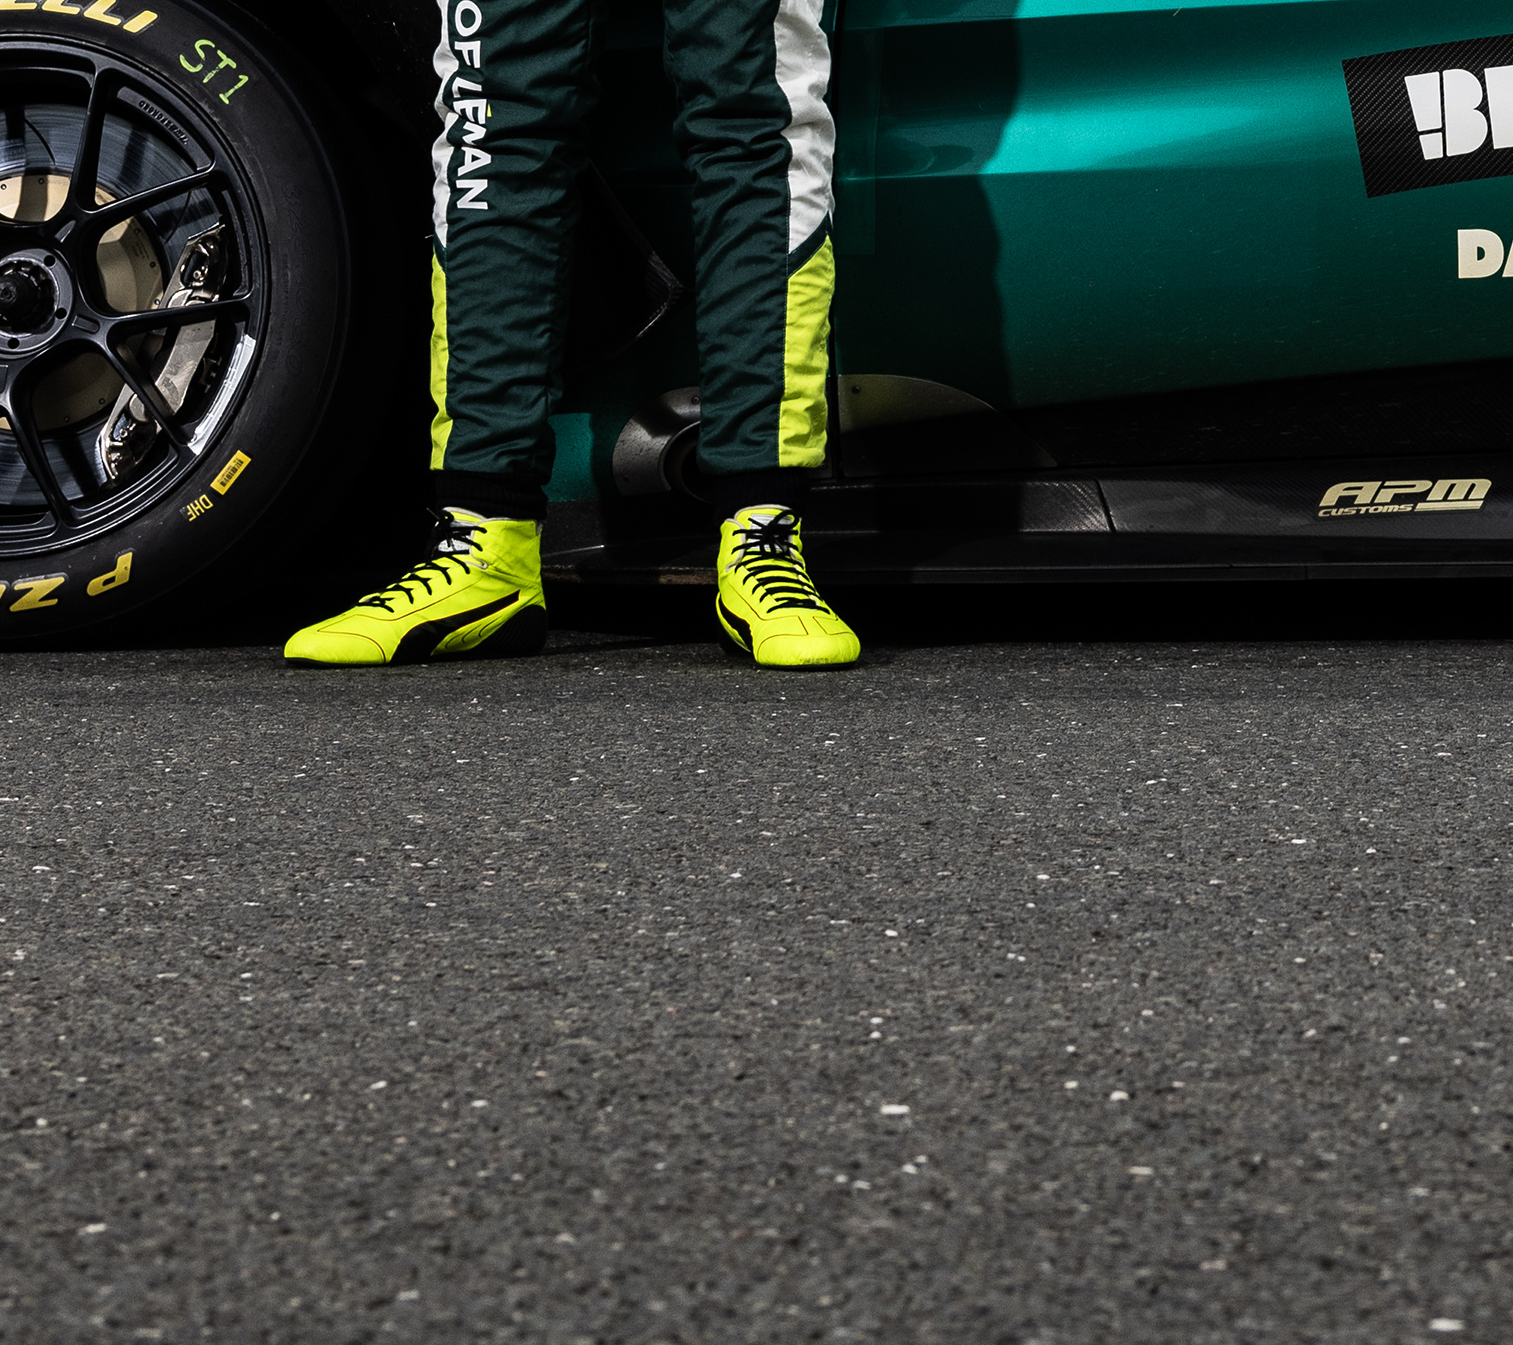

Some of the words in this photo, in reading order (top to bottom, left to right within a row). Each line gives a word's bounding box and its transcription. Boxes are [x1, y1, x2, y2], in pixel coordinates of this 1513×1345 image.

[454, 0, 483, 70] OF
[1319, 479, 1492, 506] APM
[1318, 503, 1412, 518] CUSTOMS
